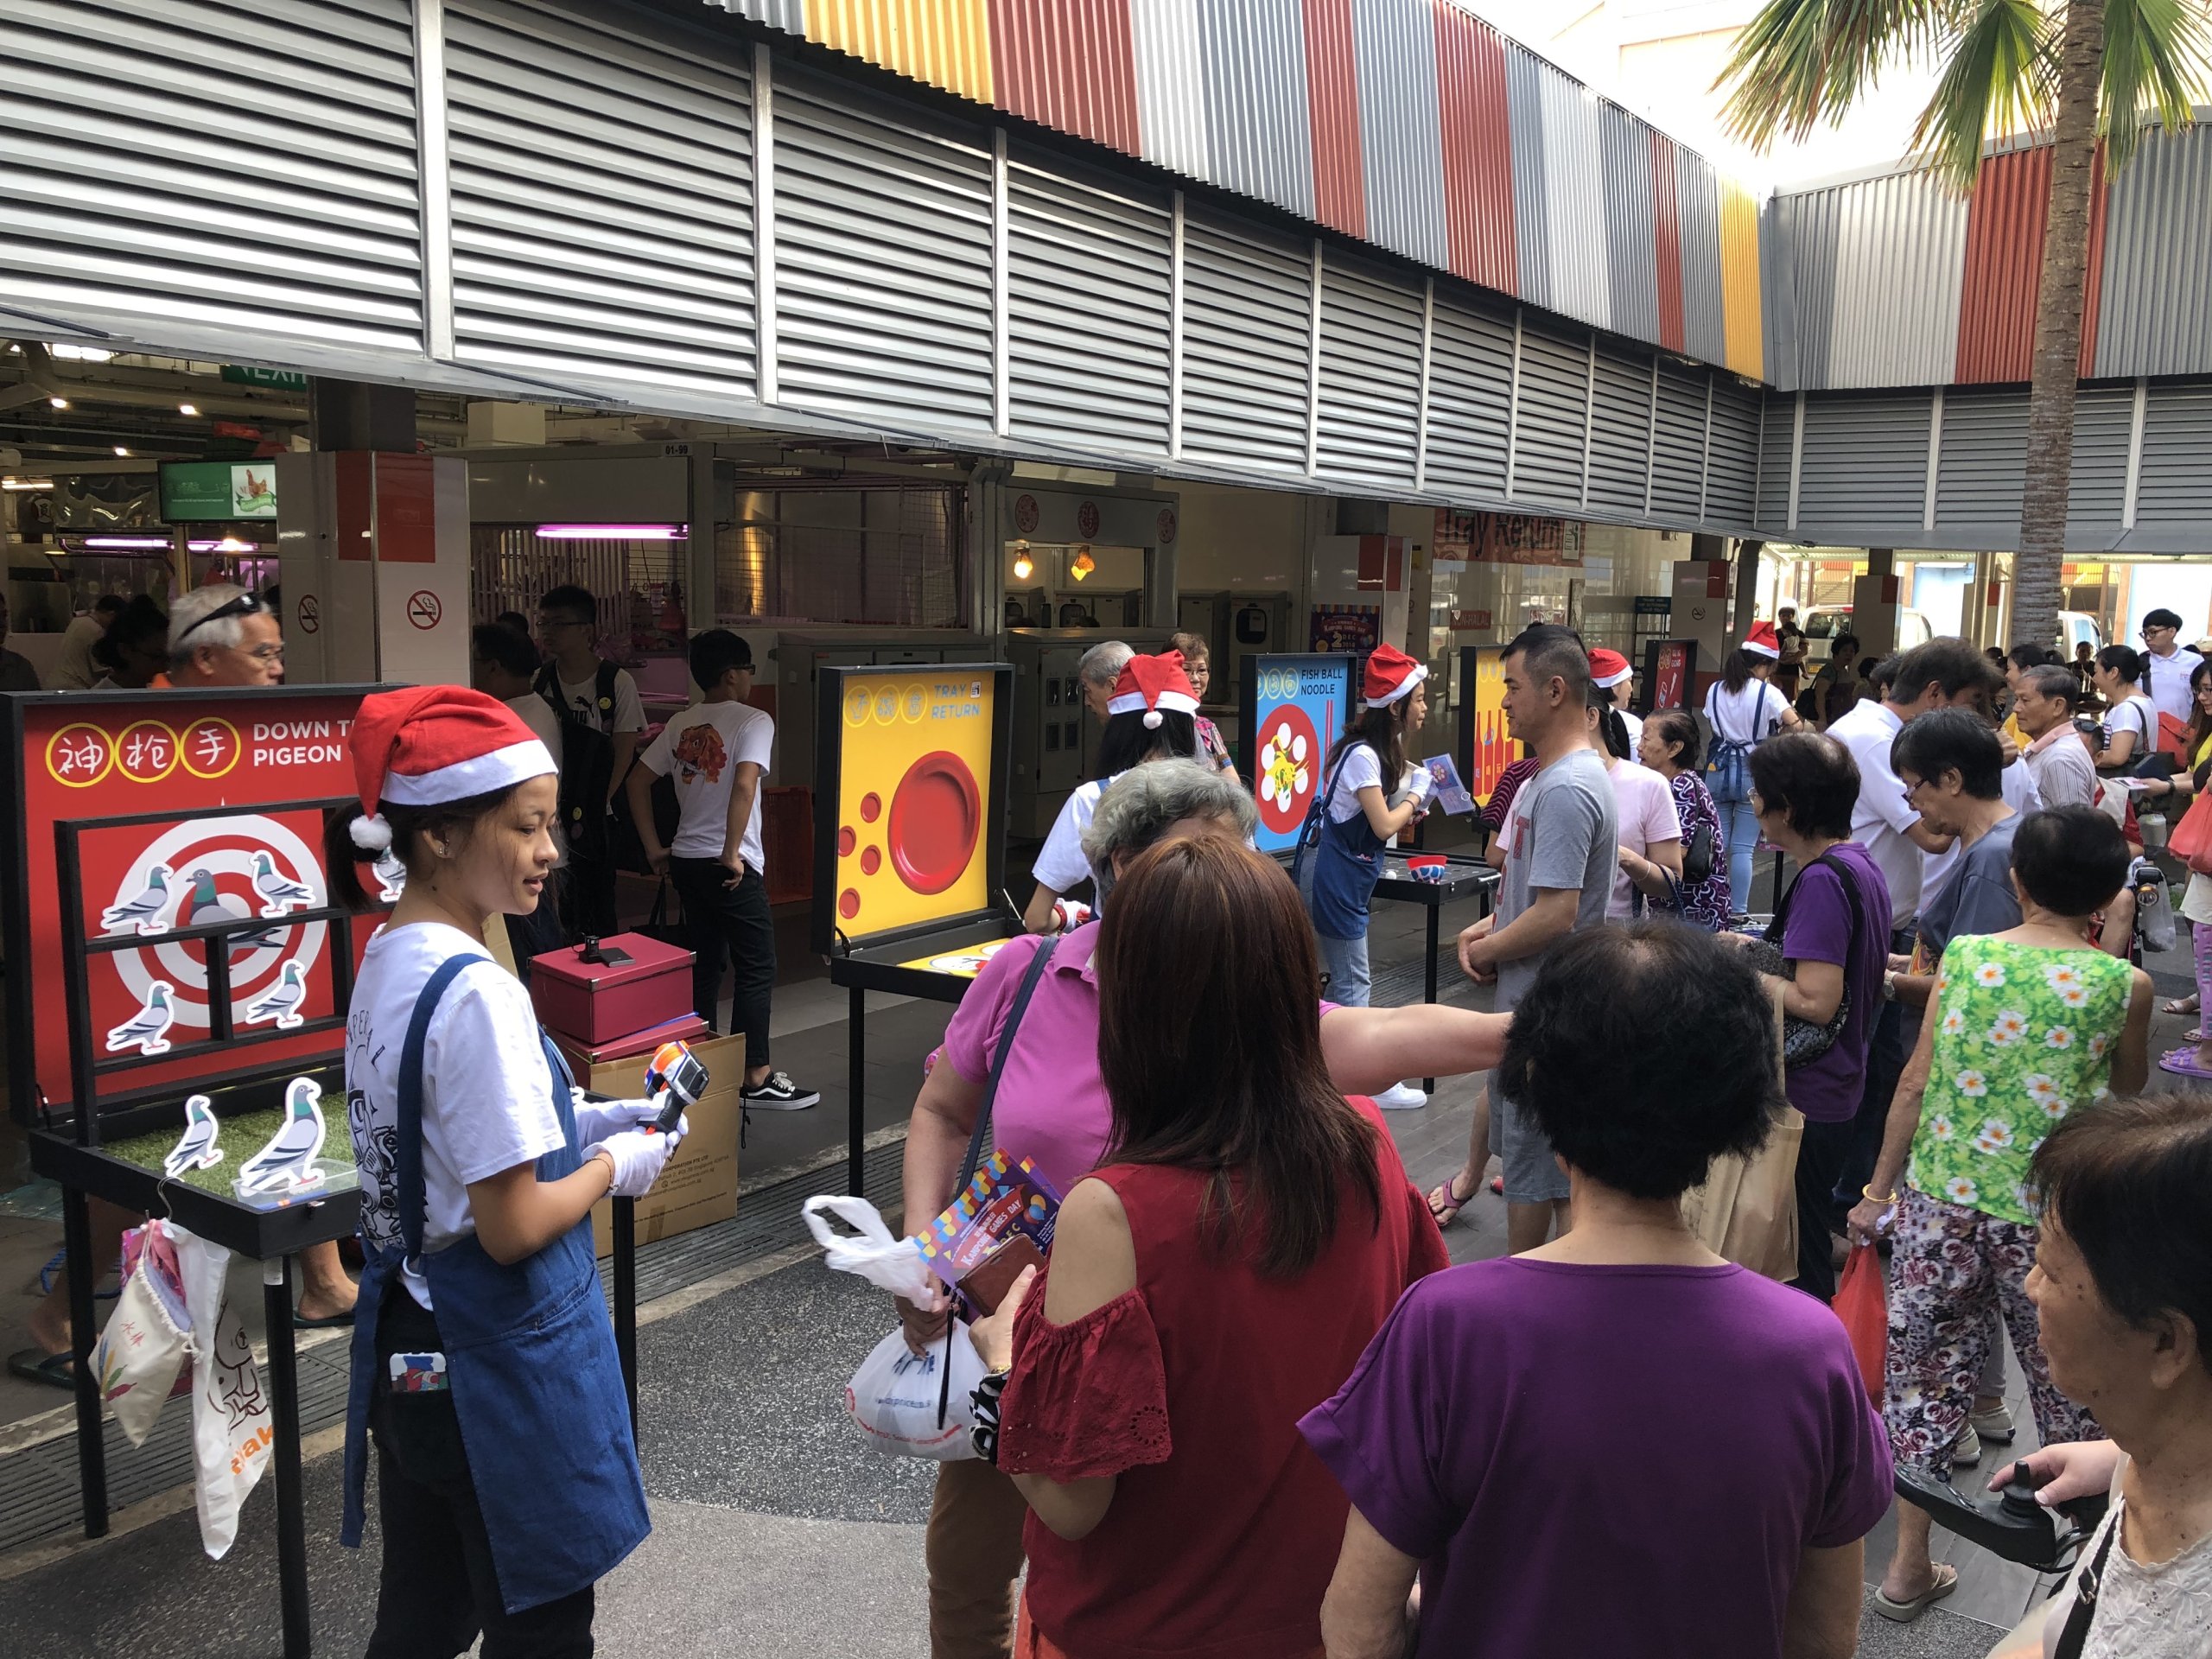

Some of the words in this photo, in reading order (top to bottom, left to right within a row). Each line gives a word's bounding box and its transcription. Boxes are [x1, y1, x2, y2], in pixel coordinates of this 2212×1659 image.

[665, 444, 689, 454] 01-99
[1301, 669, 1320, 681] FISH
[1321, 668, 1343, 680] BALL
[934, 683, 967, 699] TRAY
[1300, 683, 1335, 696] NOODLE
[932, 703, 981, 720] RETURN
[252, 719, 330, 742] DOWN
[58, 728, 226, 775] 神枪手
[252, 744, 342, 767] PIGEON
[961, 1232, 992, 1267] KAMPONG
[988, 1211, 1008, 1233] GAMES
[1007, 1198, 1021, 1214] DAY
